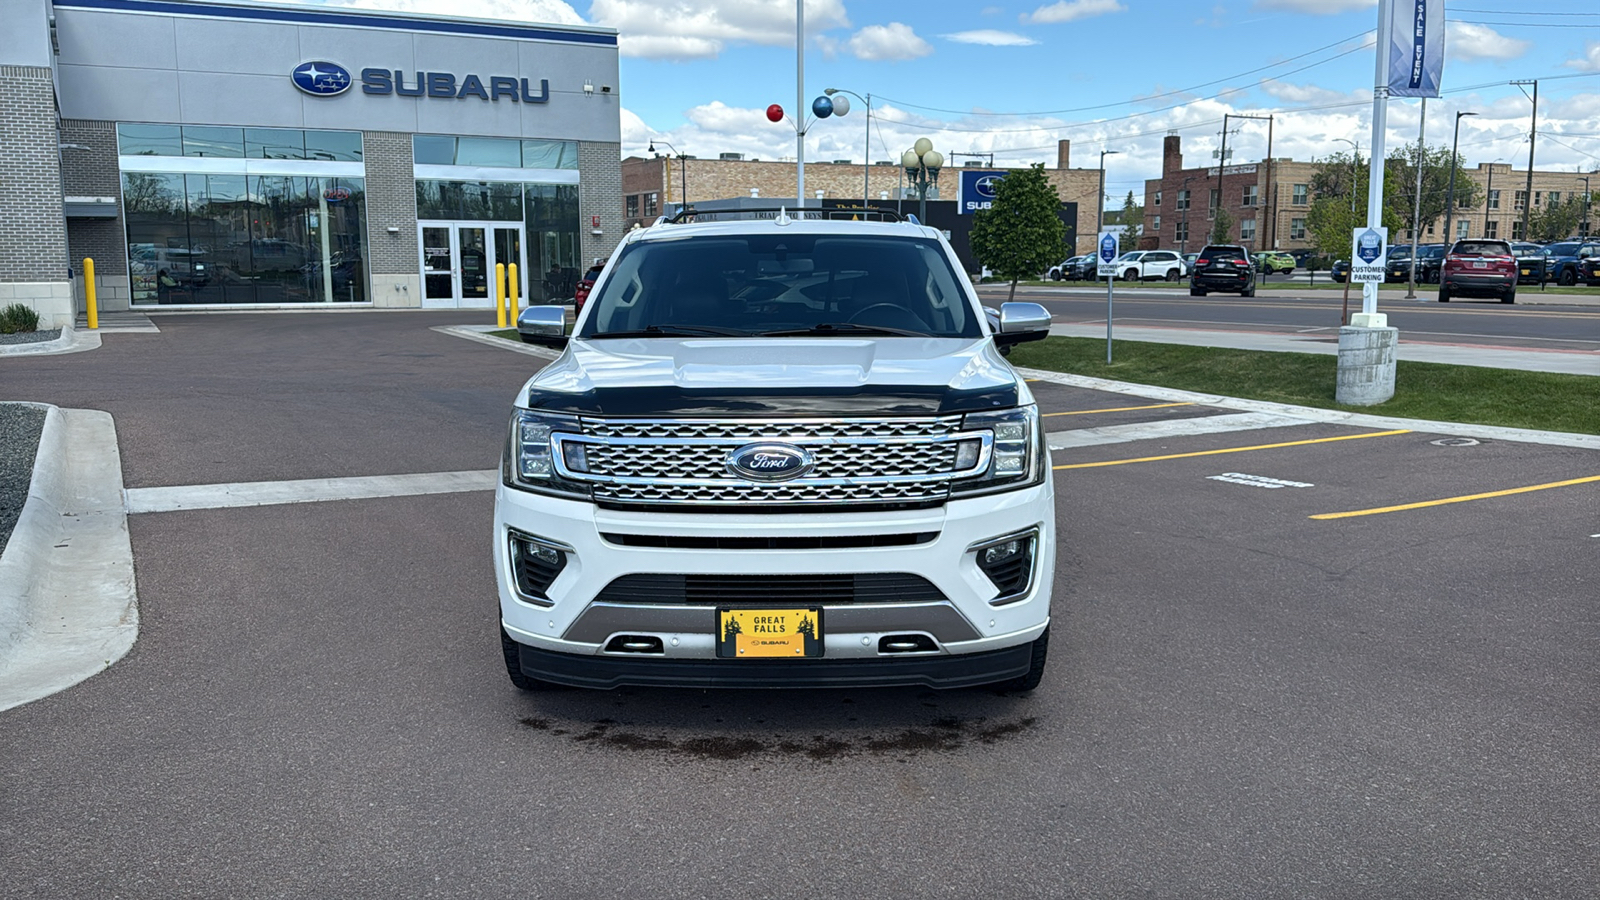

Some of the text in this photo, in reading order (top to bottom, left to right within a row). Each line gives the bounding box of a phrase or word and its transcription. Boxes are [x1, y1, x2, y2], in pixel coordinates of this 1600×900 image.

[1416, 5, 1424, 37] SALE
[1413, 45, 1422, 83] EVENT
[361, 67, 549, 103] SUBARU
[750, 453, 789, 469] Ford
[754, 616, 785, 624] GREAT
[754, 625, 785, 633] FALLS
